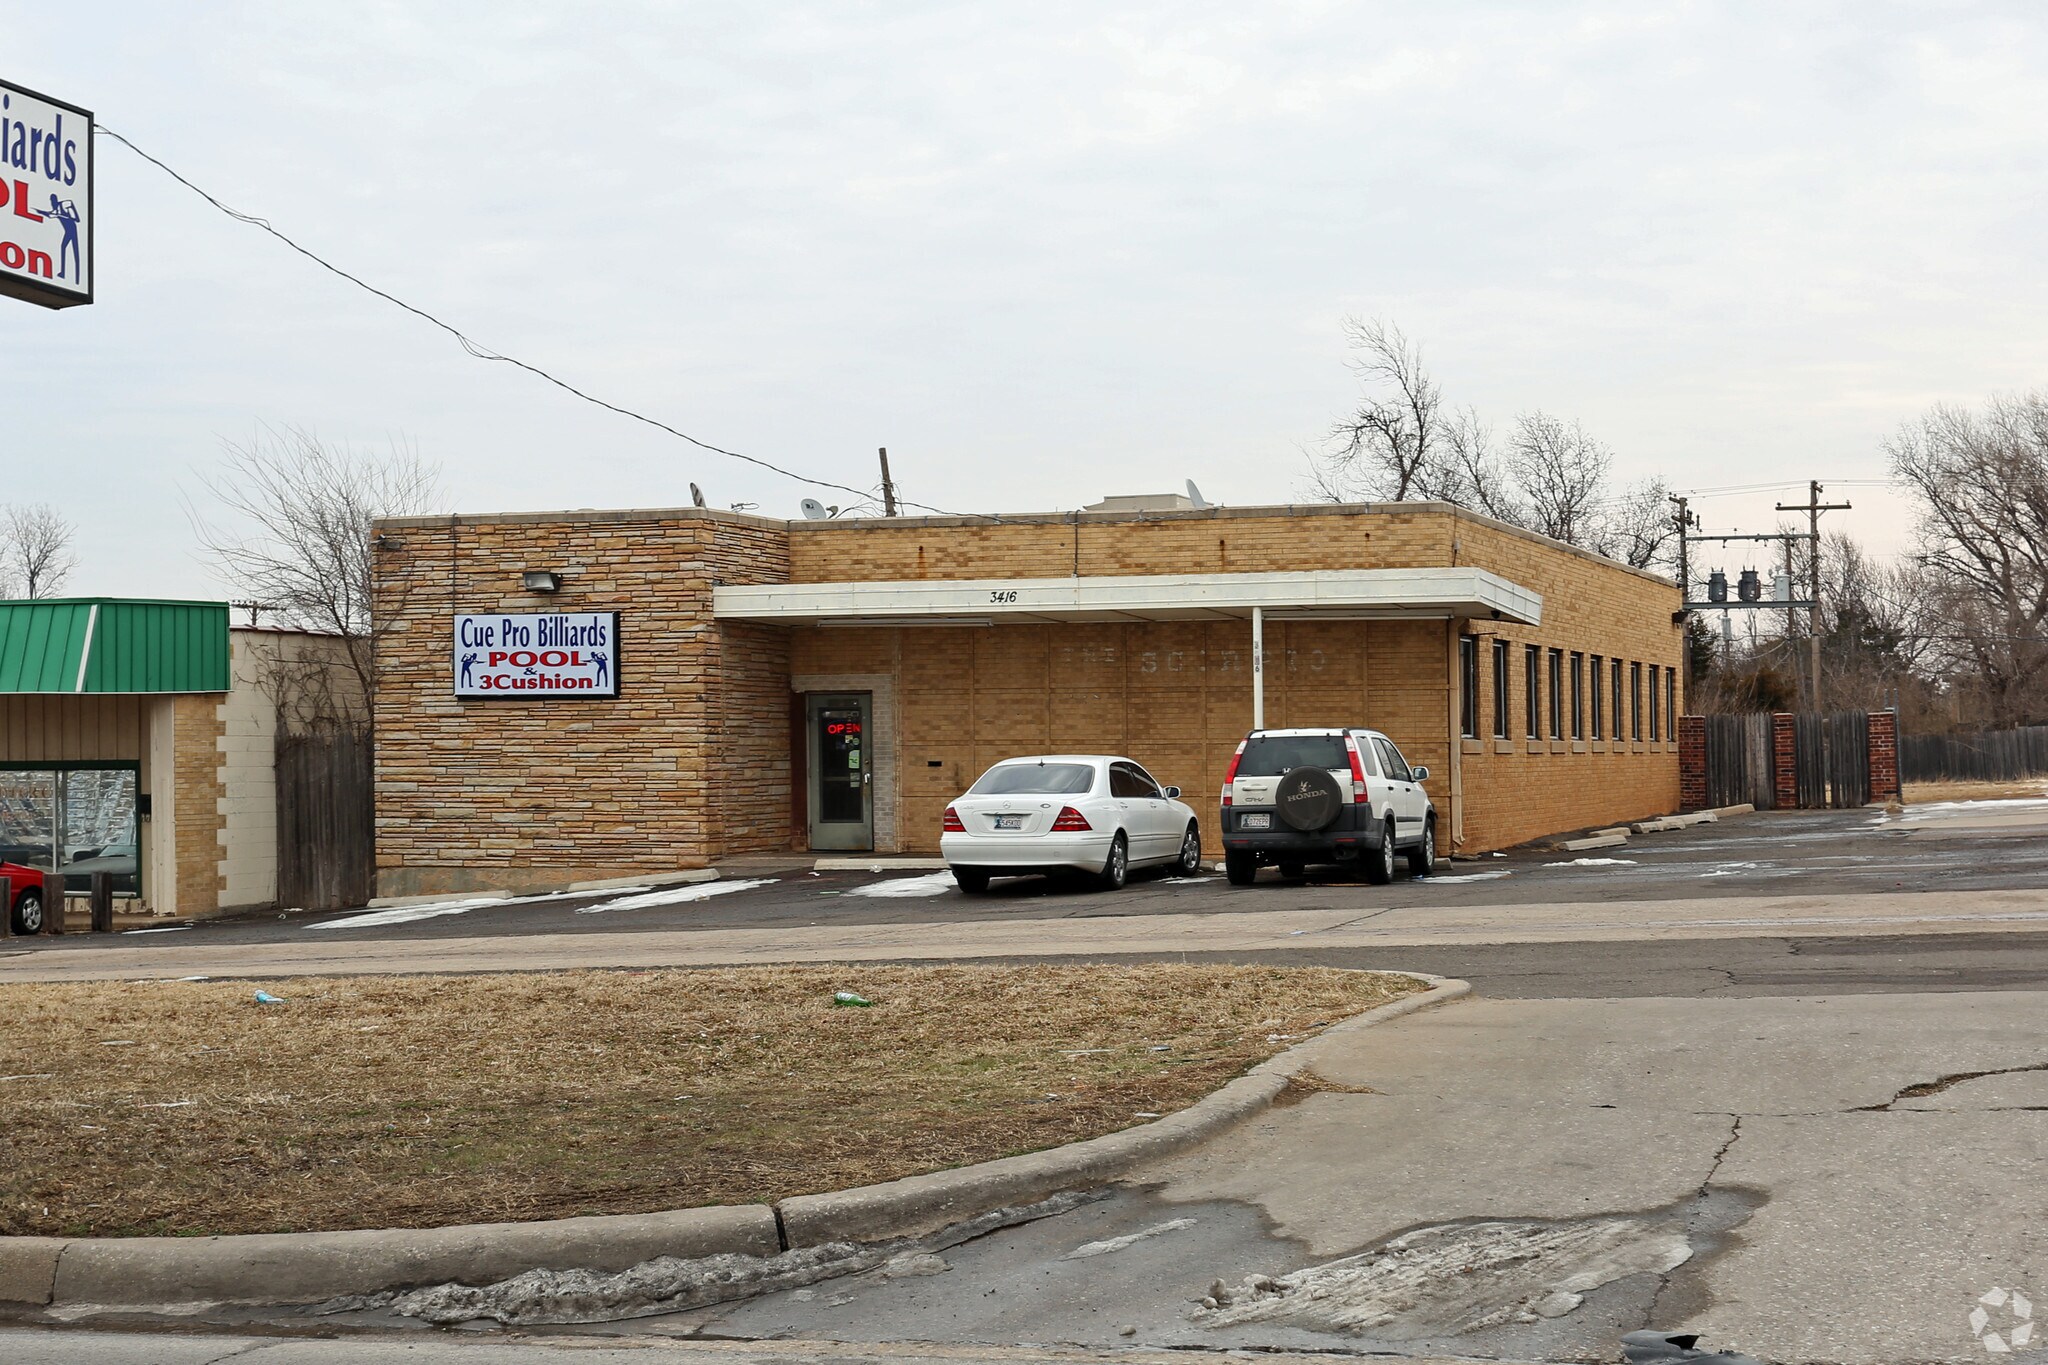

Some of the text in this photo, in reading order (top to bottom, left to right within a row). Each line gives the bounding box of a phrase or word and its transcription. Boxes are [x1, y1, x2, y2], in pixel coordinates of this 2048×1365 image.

[0, 177, 45, 223] L
[990, 591, 1018, 603] 3416
[461, 616, 606, 648] Cue Pro Billiards
[488, 650, 588, 667] POOL
[522, 667, 538, 676] &
[478, 673, 593, 690] 3Cushion
[828, 723, 861, 734] OPEN
[1287, 789, 1328, 802] HONDA
